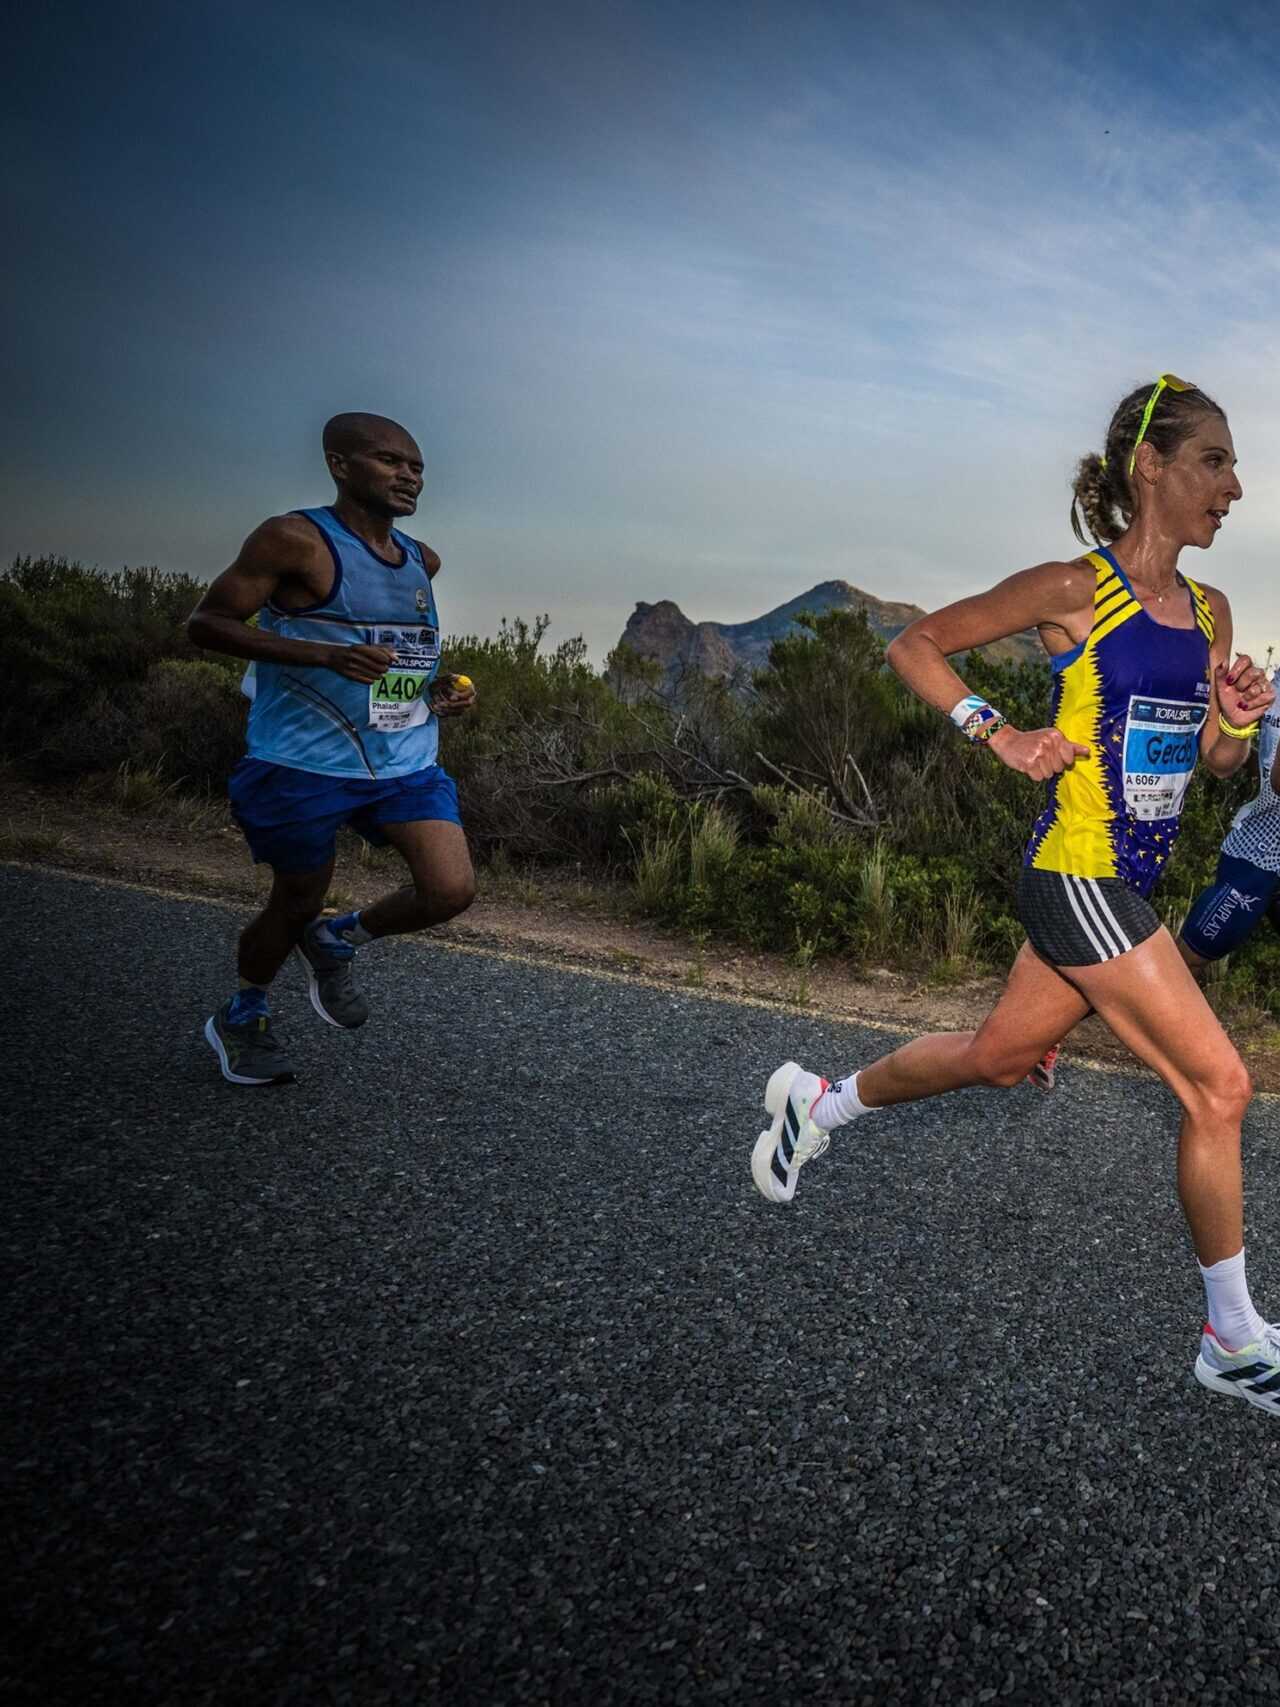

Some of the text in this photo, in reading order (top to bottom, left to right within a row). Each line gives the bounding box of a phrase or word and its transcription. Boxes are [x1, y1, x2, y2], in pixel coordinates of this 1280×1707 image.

[1126, 774, 1160, 785] A 6067
[1202, 895, 1239, 941] IMPLATS
